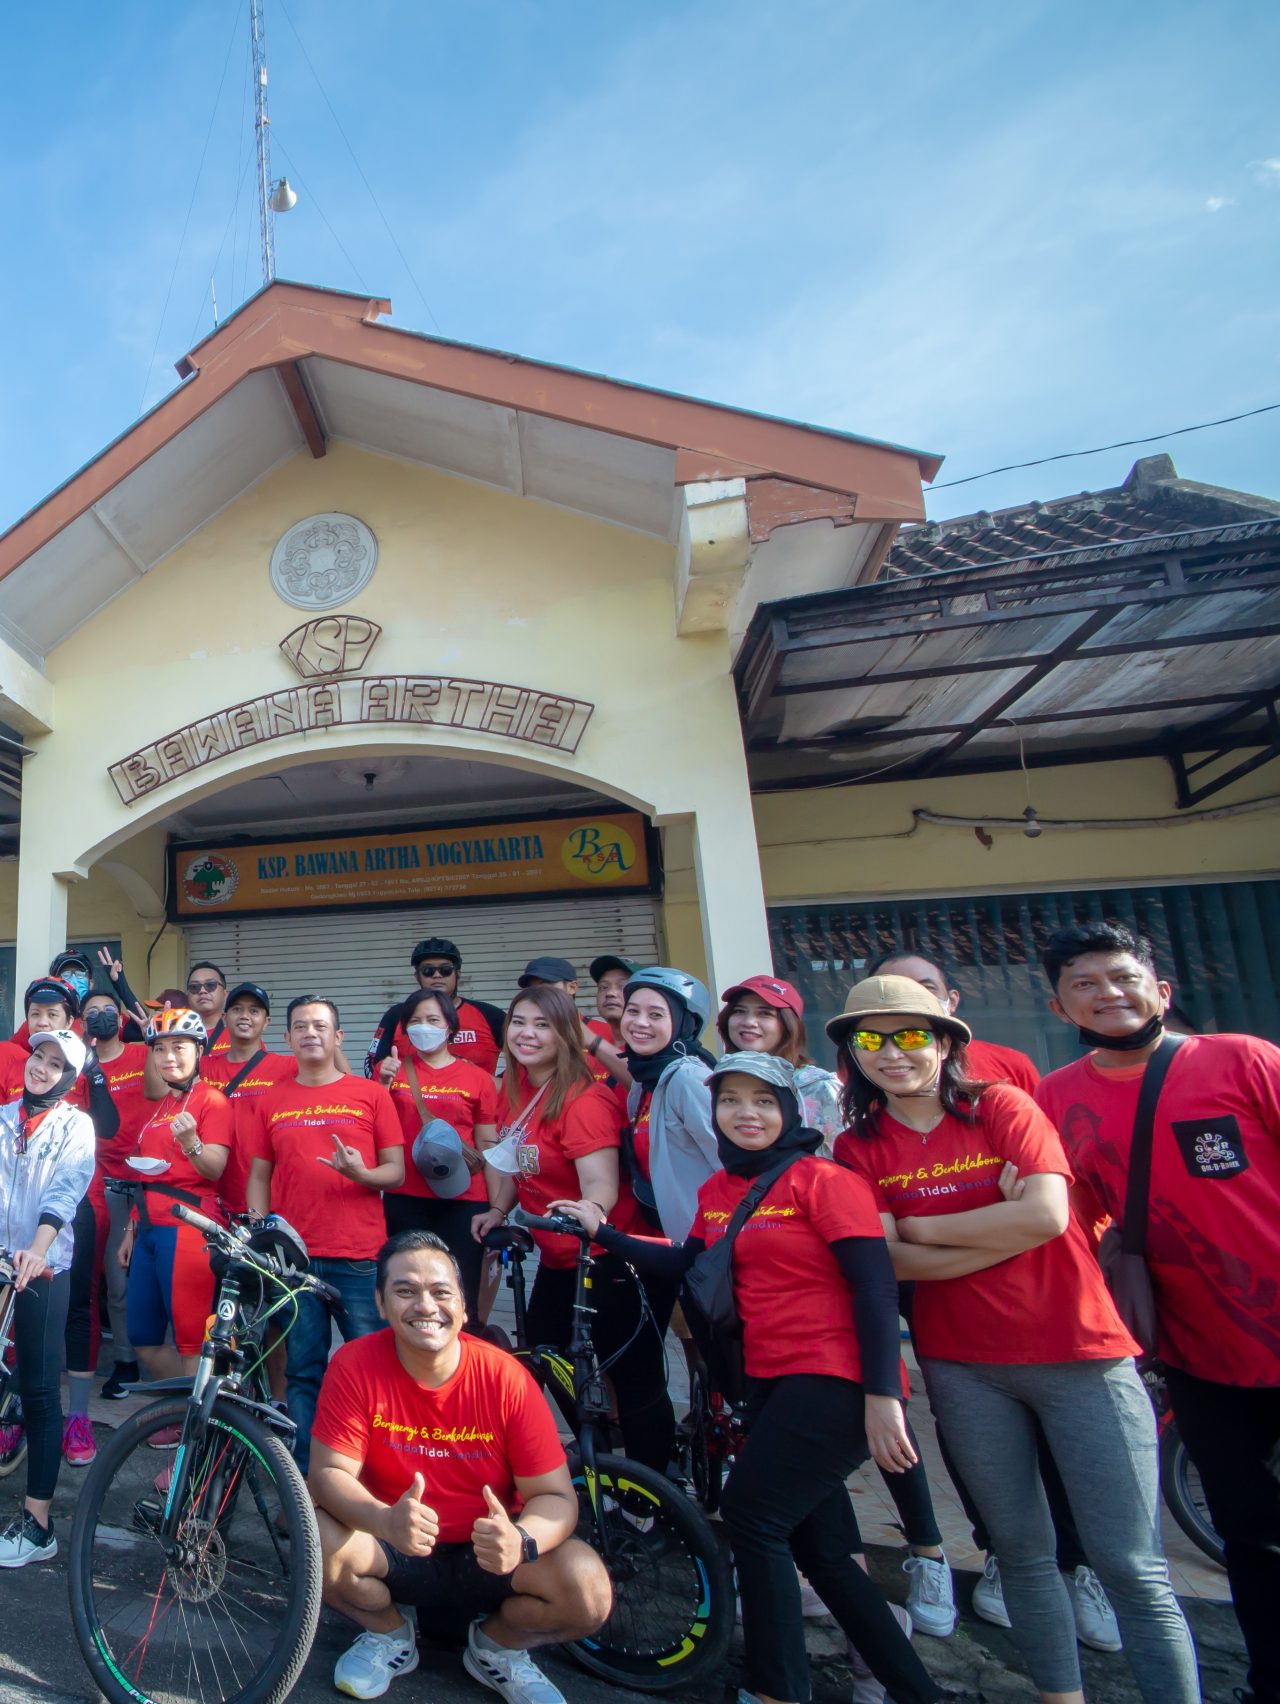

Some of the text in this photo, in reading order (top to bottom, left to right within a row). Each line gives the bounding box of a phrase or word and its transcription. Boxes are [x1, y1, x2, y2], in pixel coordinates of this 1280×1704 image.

[286, 616, 375, 676] KSP
[123, 676, 578, 799] BAWANA ARTHA
[257, 835, 545, 879] KSP. BAWANA ARTHA YOGYAKARTA
[916, 1168, 928, 1179] &
[420, 1427, 429, 1439] &
